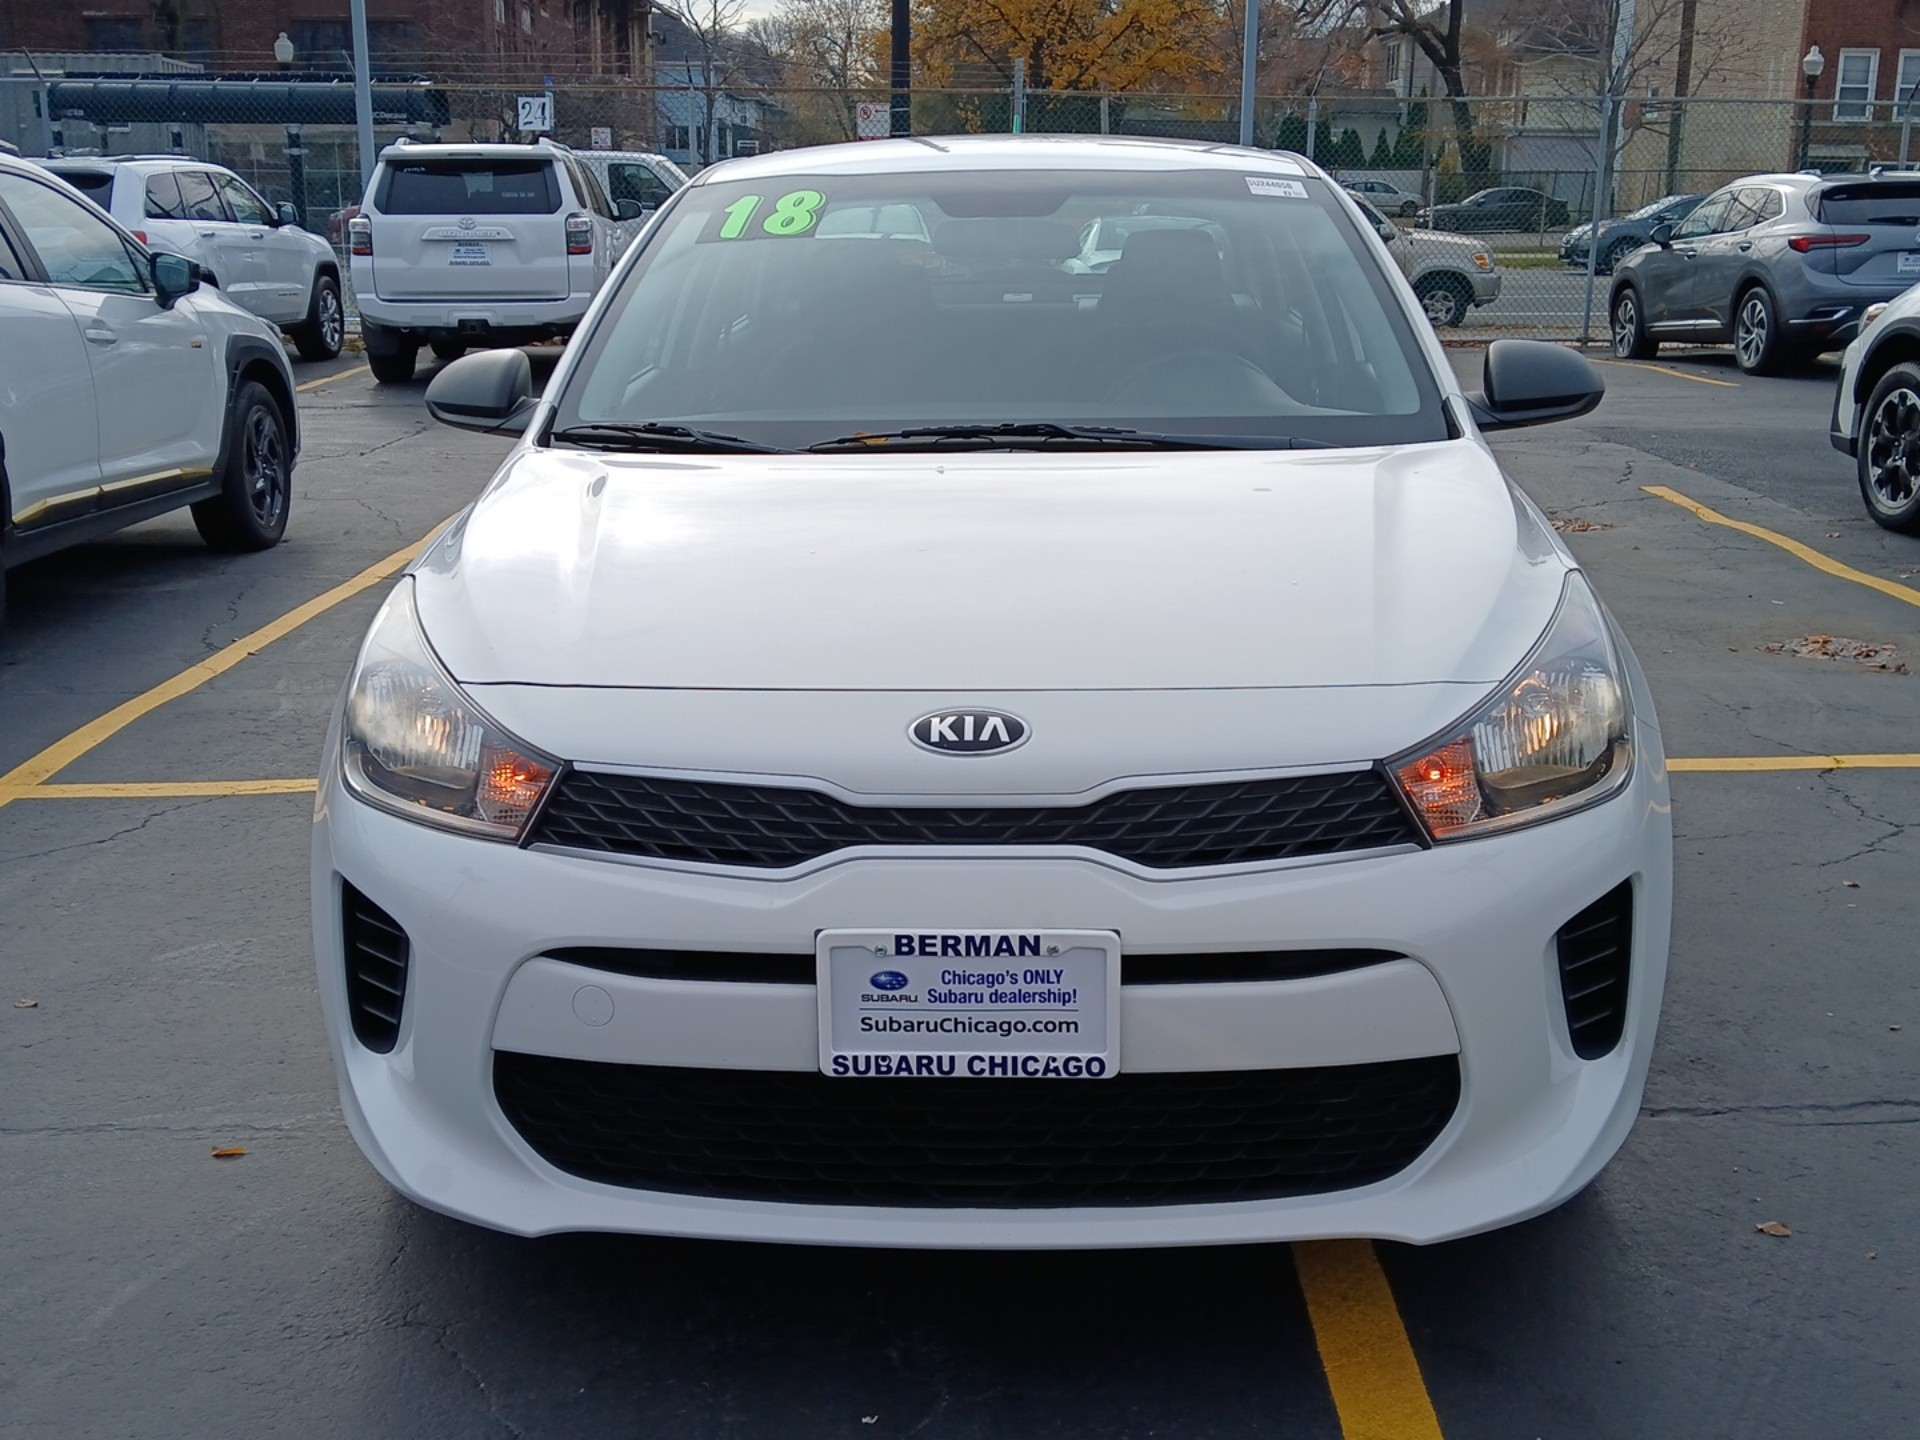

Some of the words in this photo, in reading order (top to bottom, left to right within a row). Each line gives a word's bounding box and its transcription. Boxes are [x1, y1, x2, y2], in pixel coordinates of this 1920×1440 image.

[521, 100, 547, 127] 24
[720, 190, 826, 239] 18
[930, 715, 1010, 742] KIA
[894, 934, 1041, 957] BERMAN
[940, 969, 1019, 987] Chicago's
[1023, 969, 1064, 985] ONLY
[861, 994, 918, 1003] SUBARU
[927, 988, 984, 1004] Subaru
[989, 988, 1077, 1007] dealership!
[860, 1016, 1079, 1037] SubaruChicago.com
[832, 1055, 956, 1076] SUBARU
[967, 1055, 1106, 1077] CHICAGO
